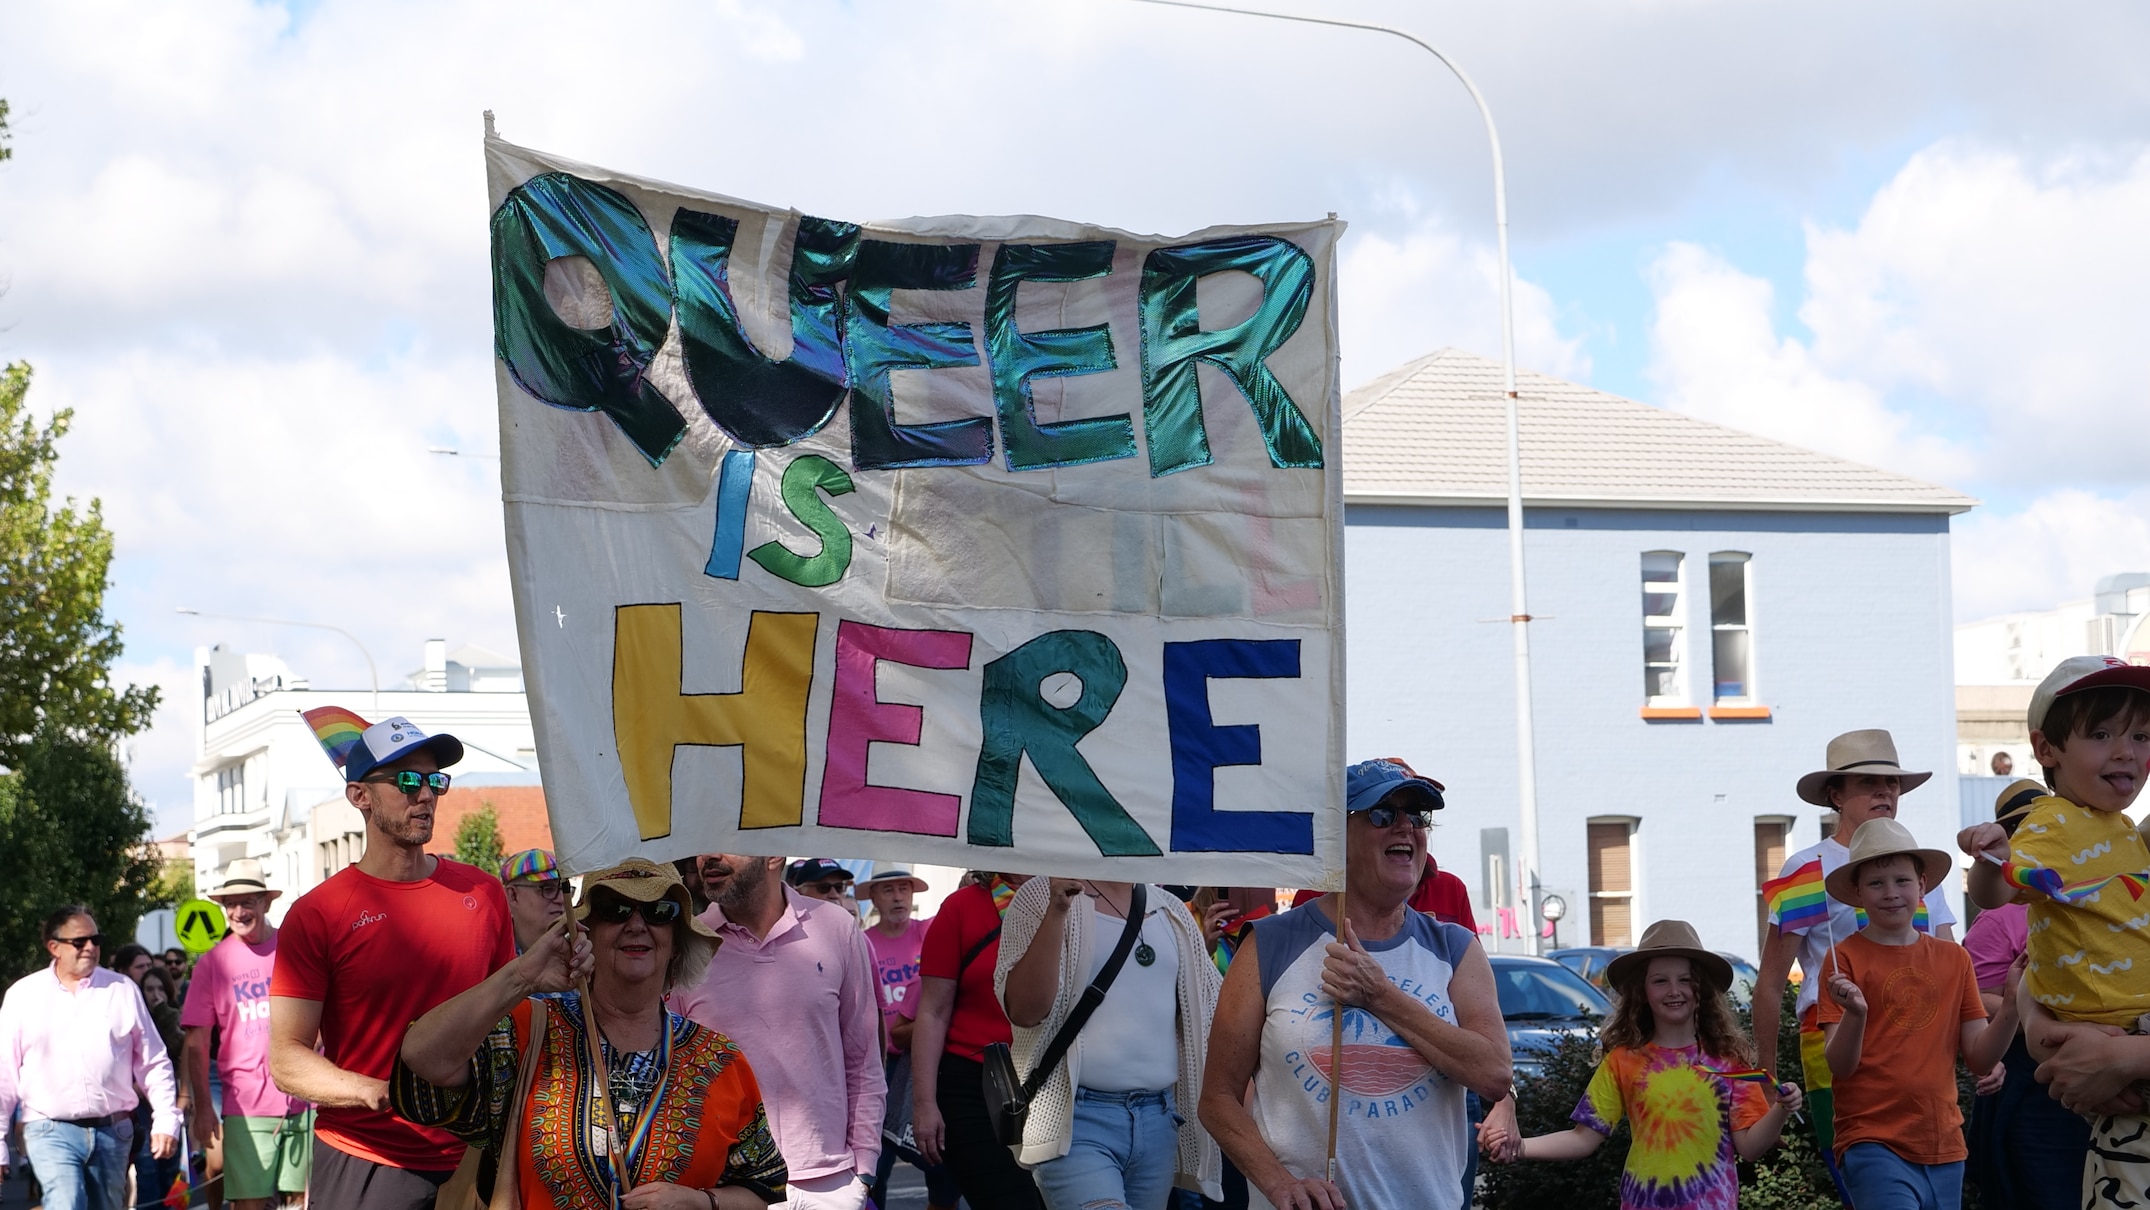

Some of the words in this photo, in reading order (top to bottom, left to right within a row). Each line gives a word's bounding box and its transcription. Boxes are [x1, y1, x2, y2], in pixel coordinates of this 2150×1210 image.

[490, 170, 1325, 479] QUEER
[704, 449, 857, 588] IS
[612, 603, 1314, 857] HERE
[352, 910, 387, 930] parkrun
[234, 977, 271, 1002] Ka
[237, 999, 271, 1022] Ho
[1291, 984, 1323, 1015] LO
[1387, 975, 1449, 1018] GELES
[1285, 1051, 1331, 1103] CLUB
